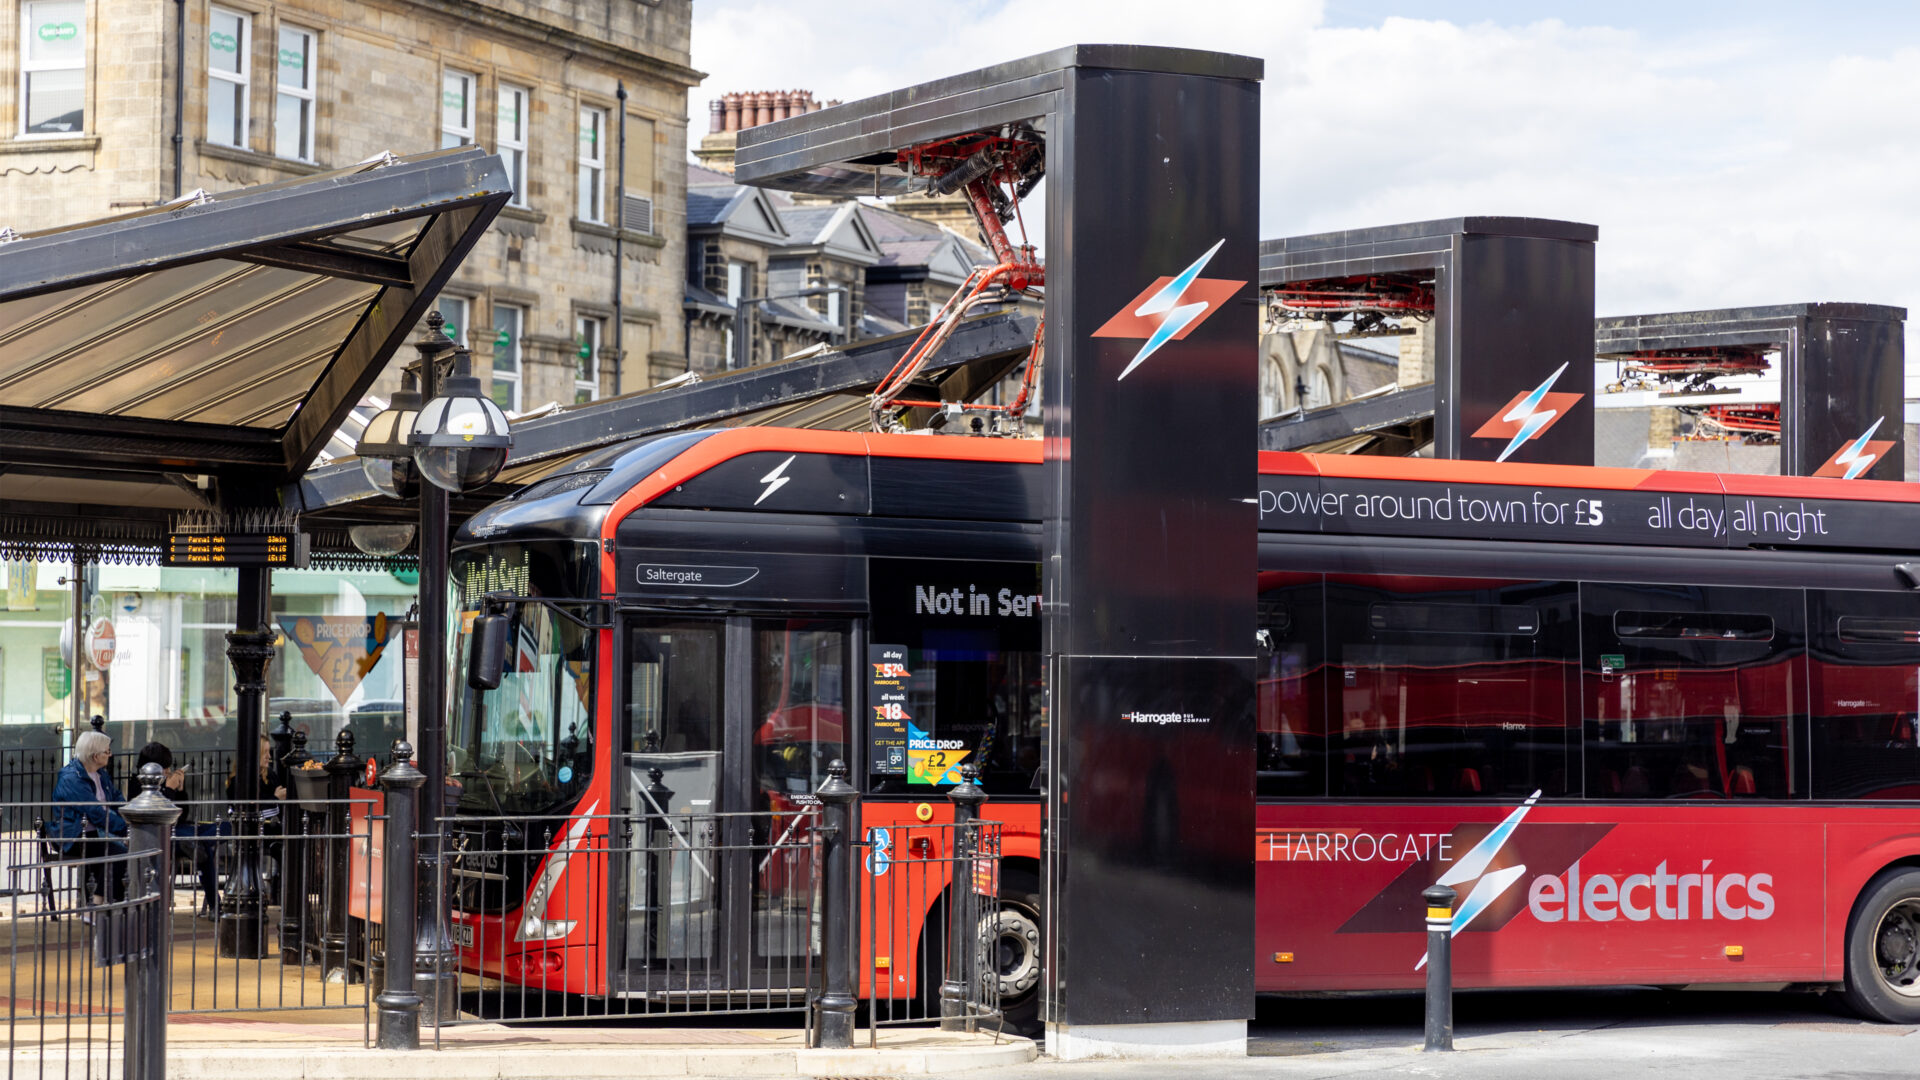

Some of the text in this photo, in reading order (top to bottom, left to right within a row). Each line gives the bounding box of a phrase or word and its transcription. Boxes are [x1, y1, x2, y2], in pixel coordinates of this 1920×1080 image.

[1259, 487, 1603, 528] power around town for £5
[1648, 497, 1828, 541] all day, all night
[646, 568, 703, 582] Saltergate
[916, 585, 964, 615] Not
[970, 584, 990, 616] in
[317, 623, 371, 638] PRICE DROP
[332, 652, 355, 682] £2
[876, 703, 902, 720] £18
[1130, 712, 1182, 724] Harrogate
[909, 740, 964, 749] PRICE DROP
[890, 755, 902, 765] go
[928, 752, 946, 767] £2
[1269, 834, 1453, 861] HARROGATE
[1528, 859, 1775, 922] electrics
